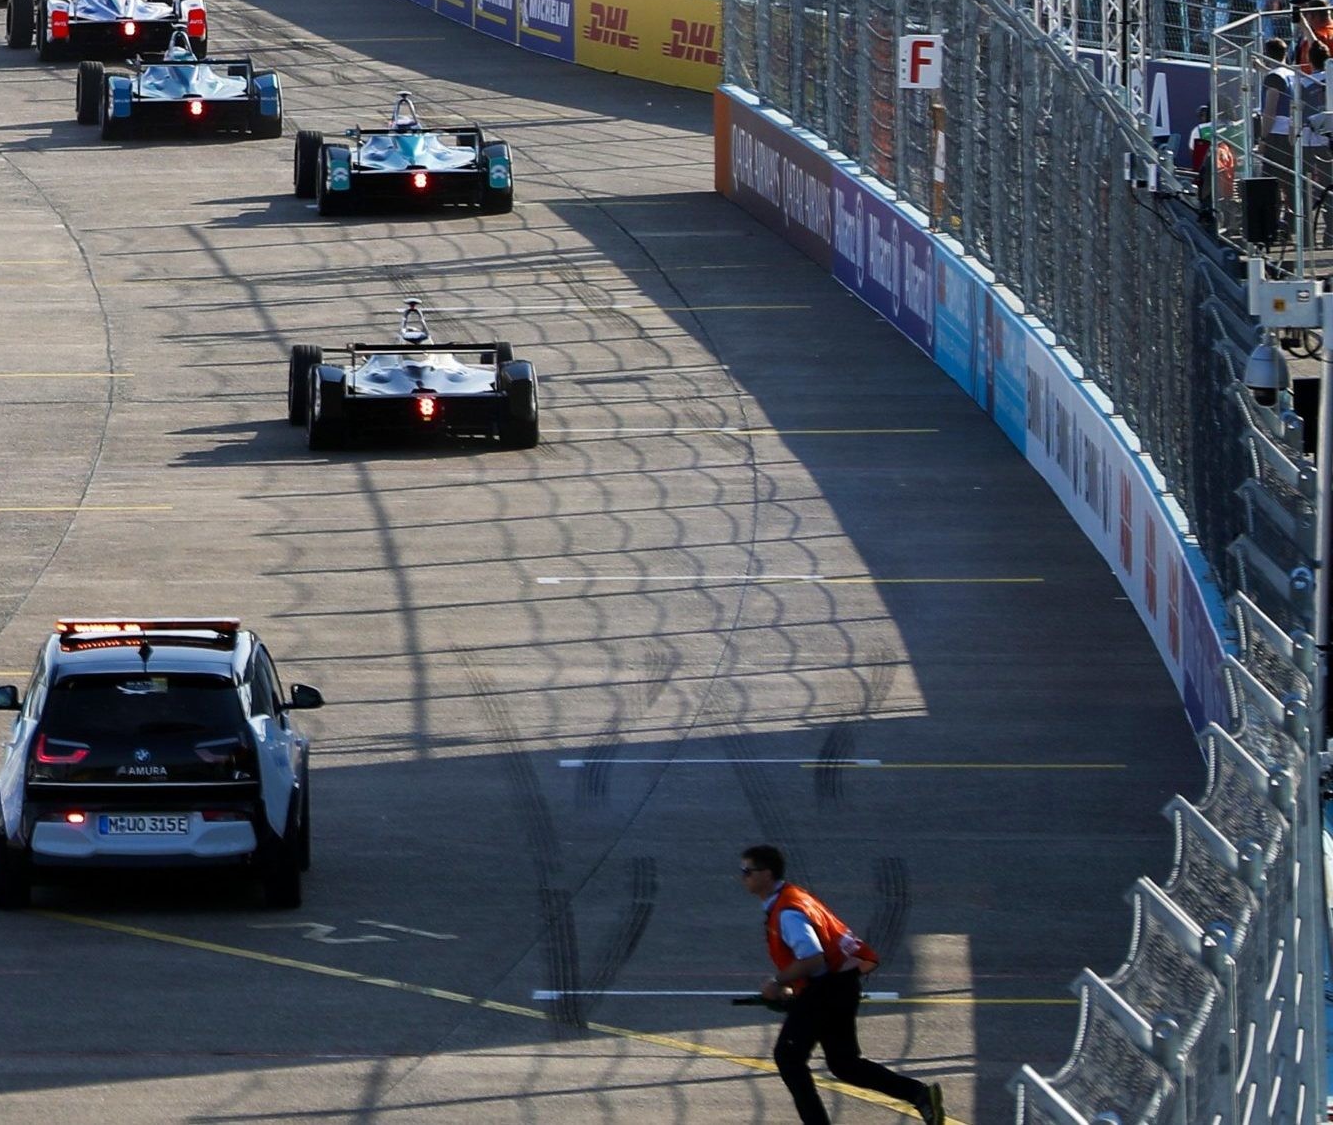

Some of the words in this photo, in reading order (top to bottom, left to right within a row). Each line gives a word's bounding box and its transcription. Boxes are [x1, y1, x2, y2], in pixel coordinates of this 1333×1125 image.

[587, 2, 635, 49] DHL
[667, 18, 721, 66] DHL
[910, 40, 935, 84] F
[129, 766, 168, 776] AMURA
